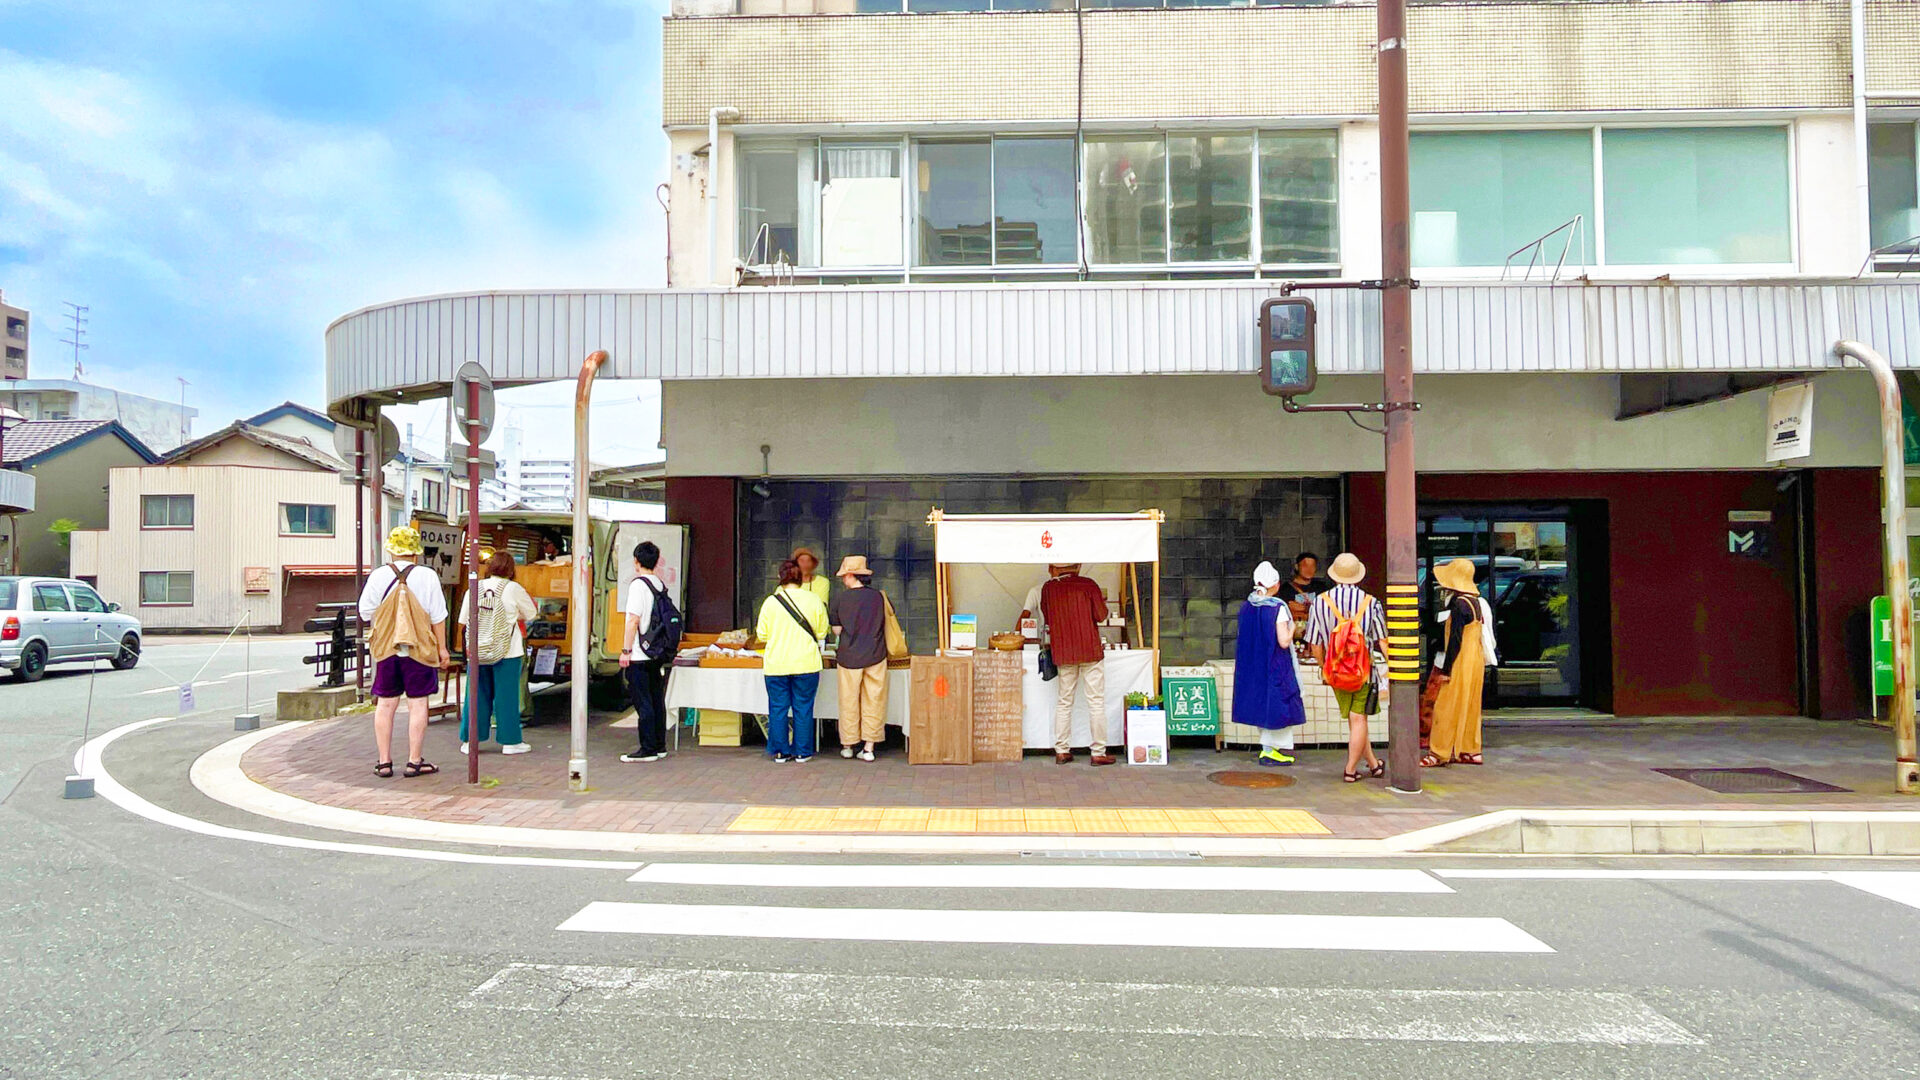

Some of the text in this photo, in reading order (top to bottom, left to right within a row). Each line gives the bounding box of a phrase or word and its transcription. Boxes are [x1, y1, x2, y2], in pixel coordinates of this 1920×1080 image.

[421, 530, 458, 545] ROAST
[1167, 722, 1188, 732] いちご
